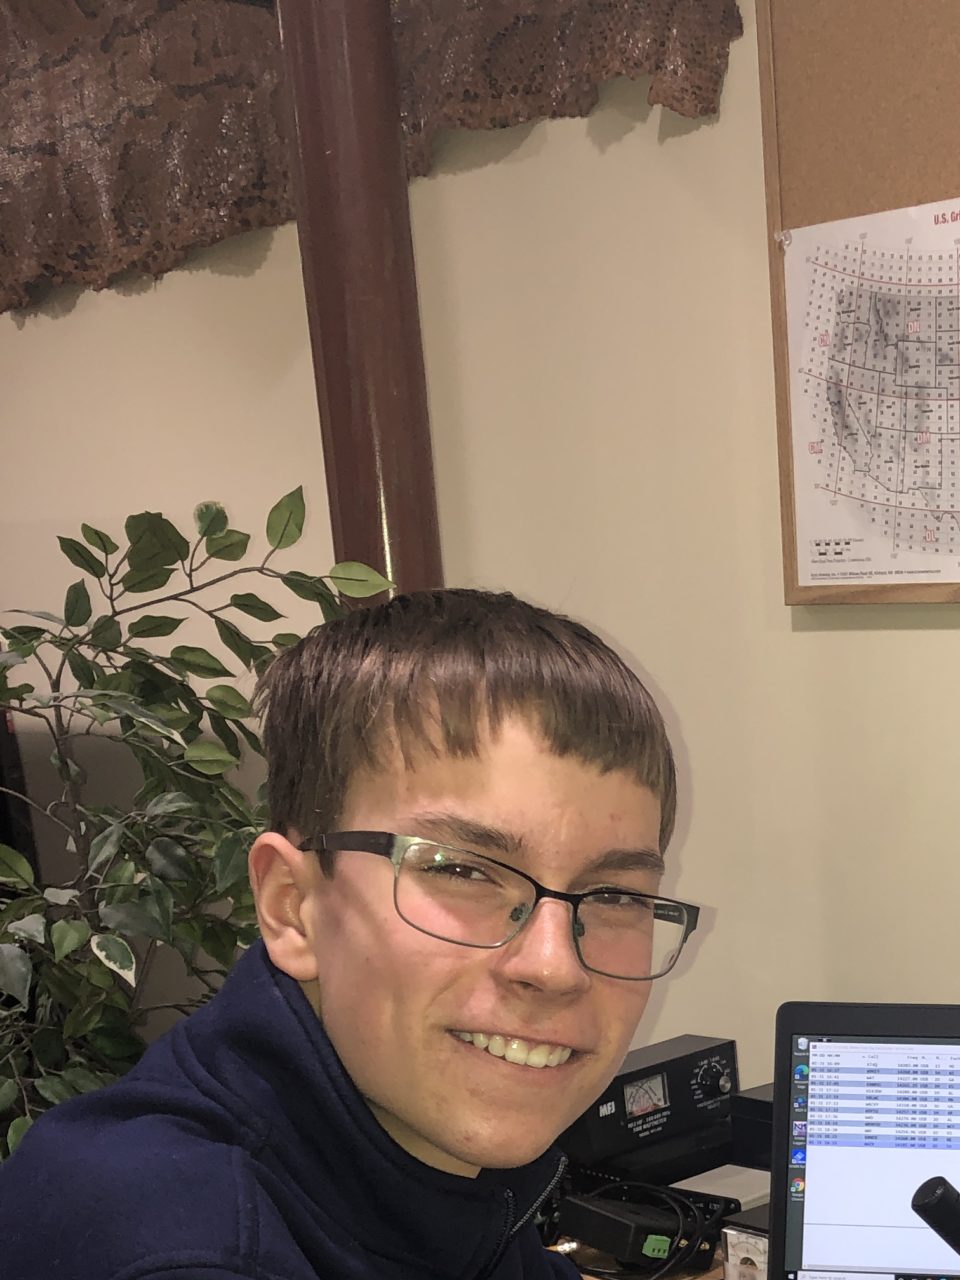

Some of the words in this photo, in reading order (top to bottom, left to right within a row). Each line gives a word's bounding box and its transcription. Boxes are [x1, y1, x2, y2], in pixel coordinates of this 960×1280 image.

[934, 212, 949, 225] U.S.
[908, 321, 921, 334] DN
[917, 432, 931, 445] DM
[925, 530, 937, 541] DL
[599, 1101, 615, 1117] MFJ
